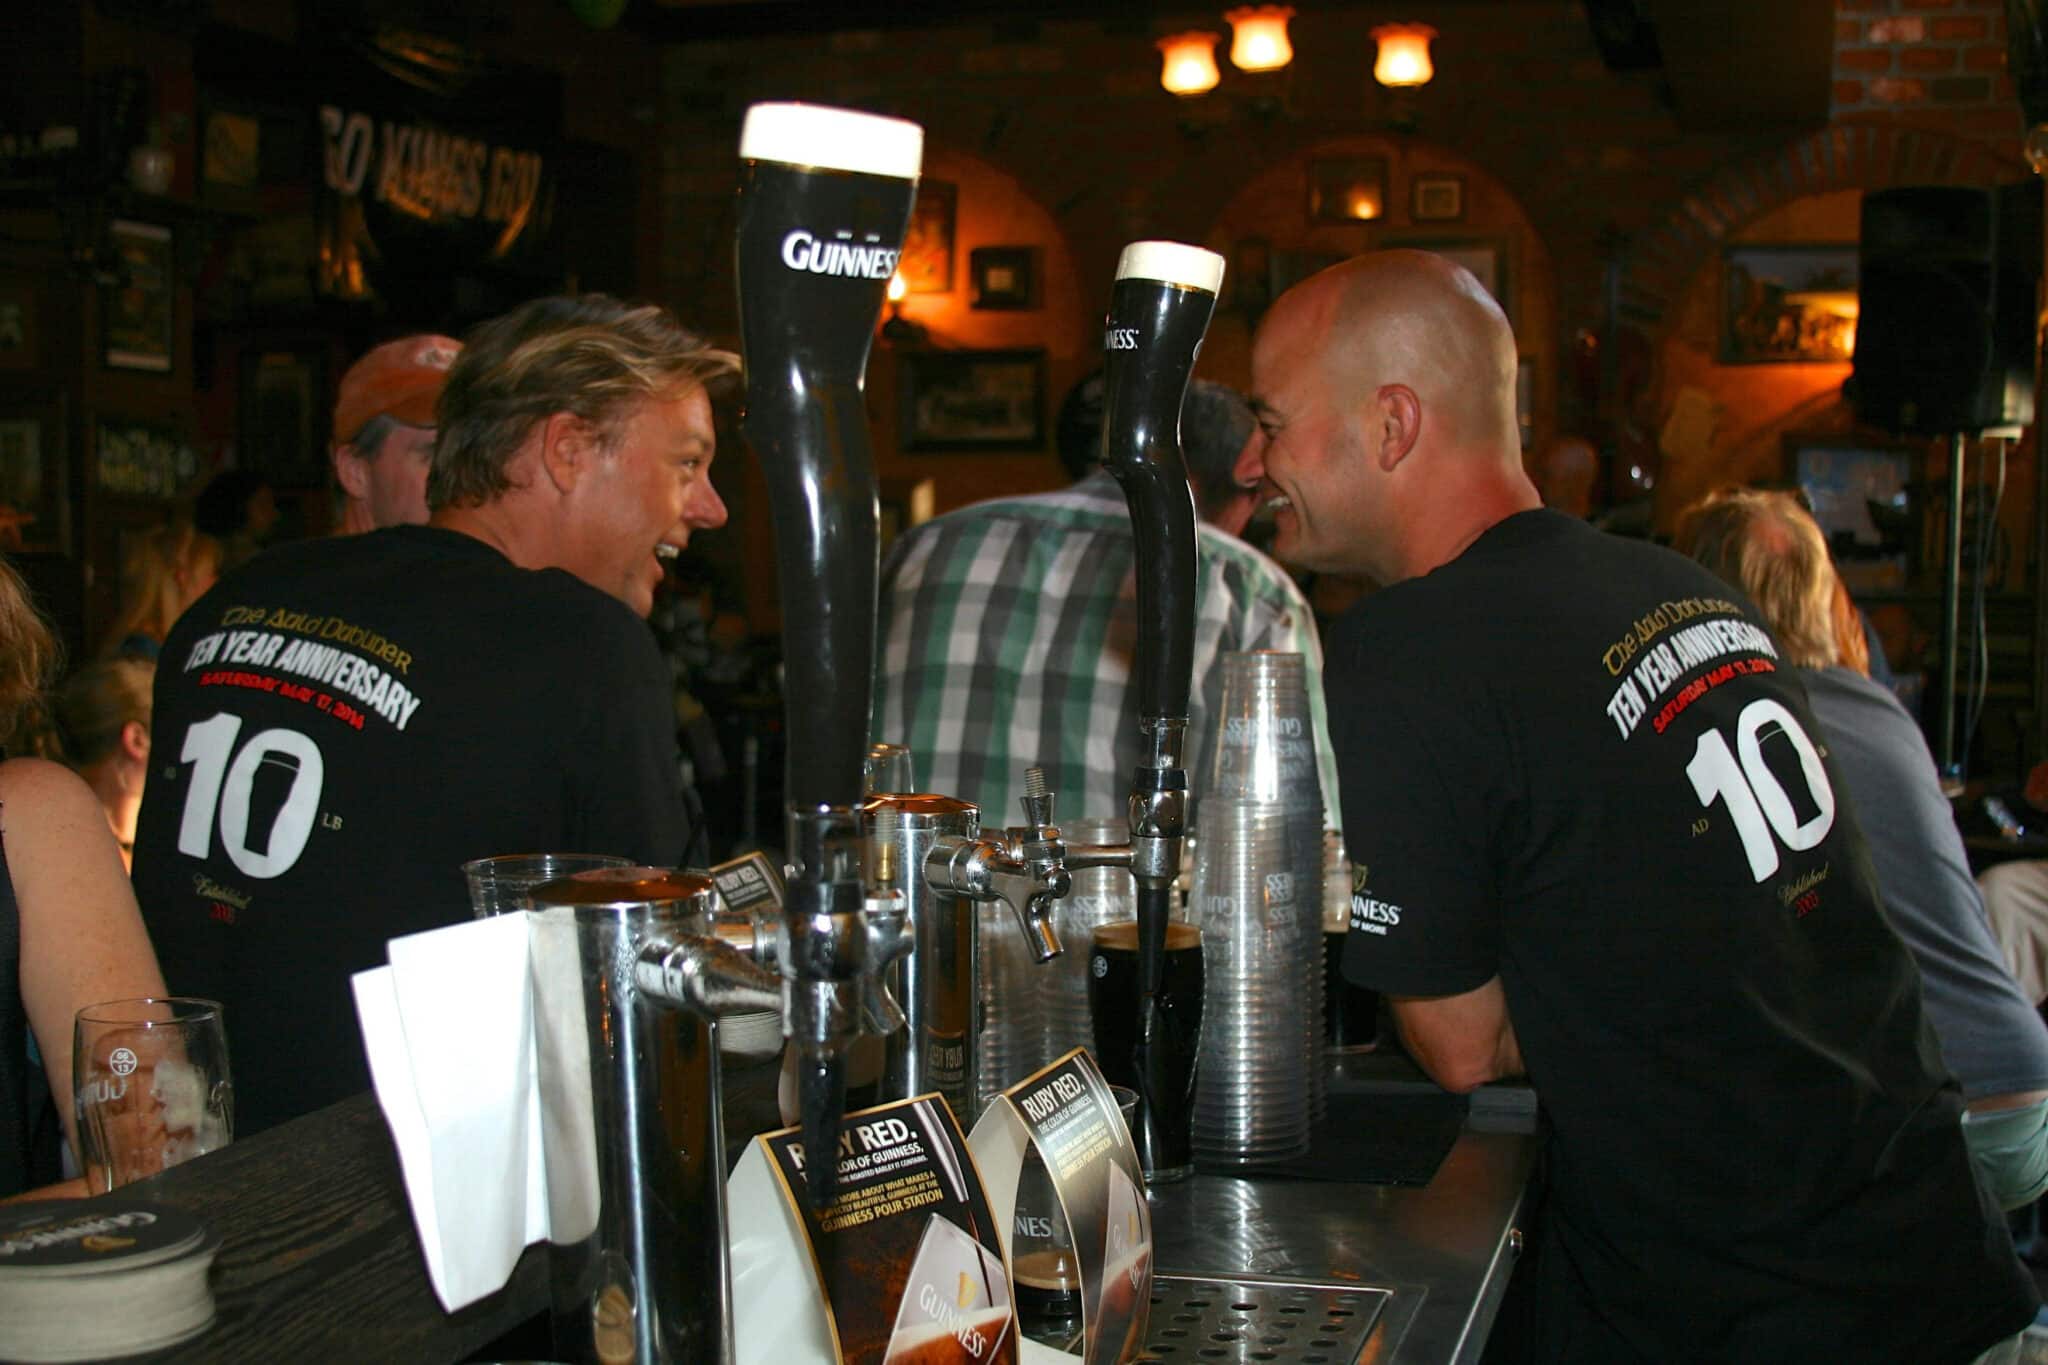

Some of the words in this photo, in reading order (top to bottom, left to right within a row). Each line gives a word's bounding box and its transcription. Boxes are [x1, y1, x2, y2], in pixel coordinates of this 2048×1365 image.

[184, 632, 227, 673] TEN
[219, 631, 285, 668] YEAR
[275, 639, 421, 732] ANNIVERSARY
[1606, 675, 1647, 741] TEN
[1634, 642, 1684, 702] YEAR
[1669, 619, 1779, 672] ANNIVERSARY
[1652, 676, 1709, 735] SATURDAY
[1705, 663, 1737, 688] MAY
[177, 711, 324, 880] 10
[1686, 698, 1835, 883] 10
[322, 812, 343, 831] LB
[1021, 1084, 1060, 1123] RUBY
[1052, 1072, 1086, 1103] RED.
[855, 1118, 918, 1151] RED.
[857, 1155, 872, 1169] OF
[821, 1208, 874, 1232] GUINNESS
[874, 1199, 905, 1218] POUR
[904, 1188, 944, 1210] STATION
[861, 1185, 885, 1199] ABOUT
